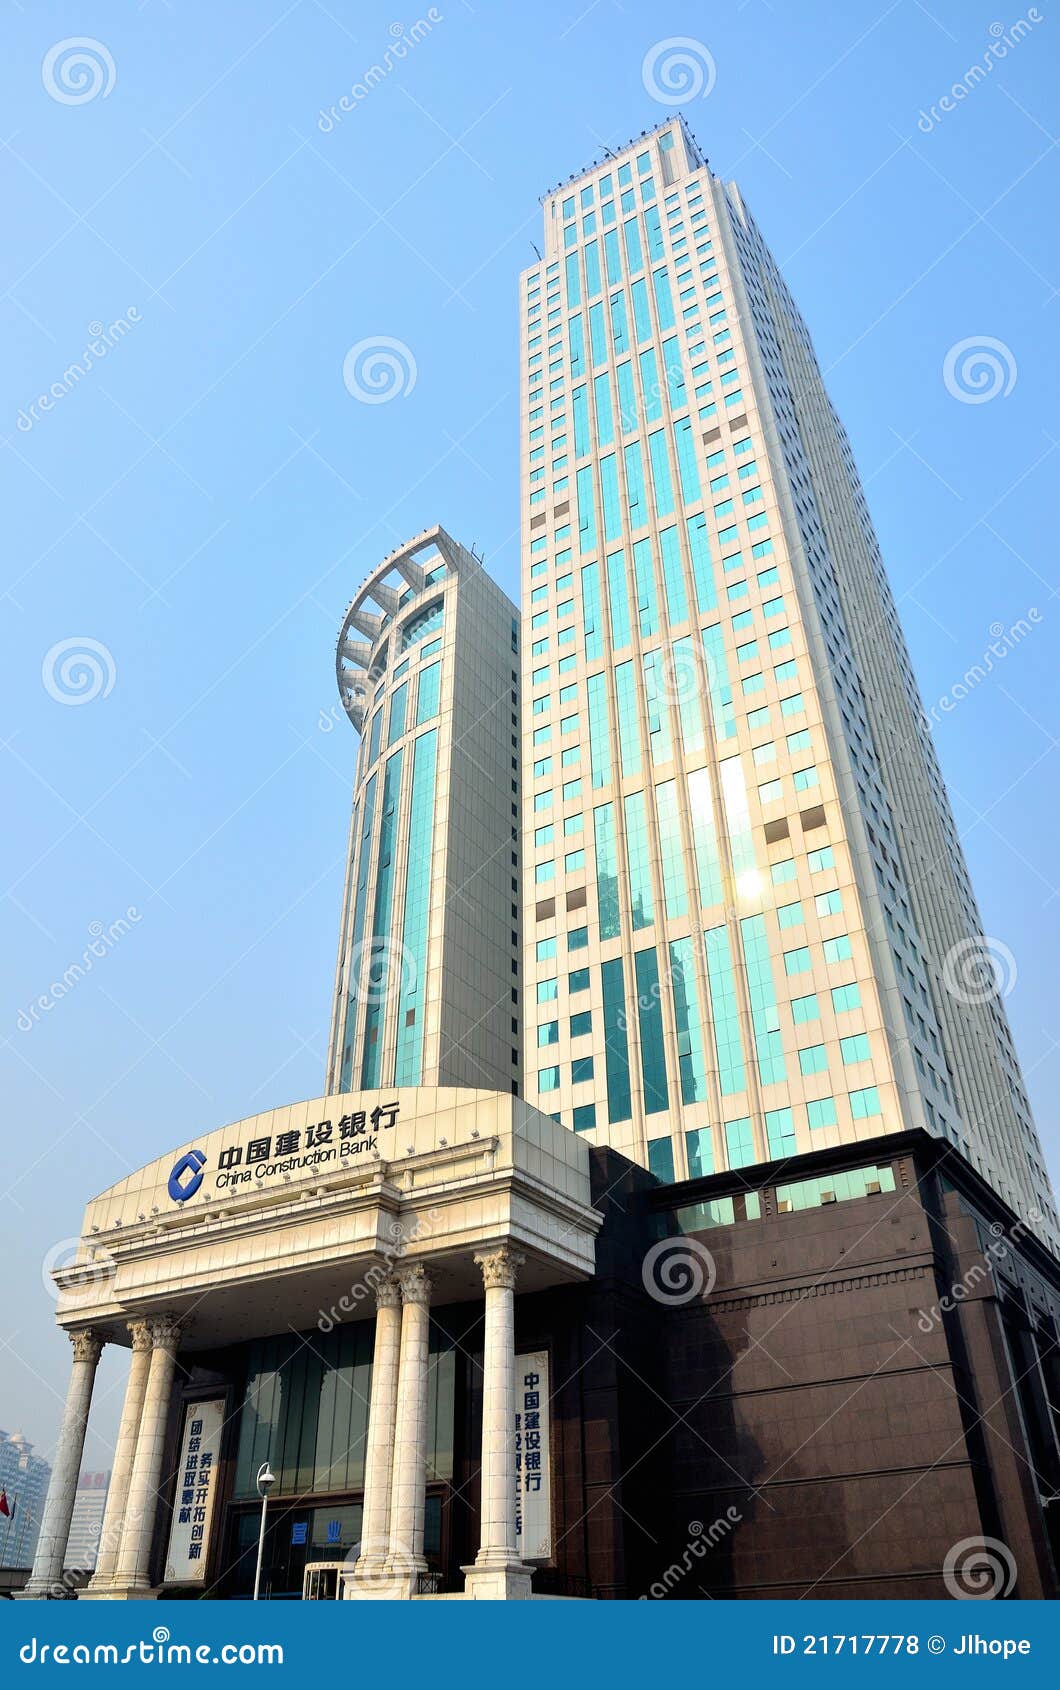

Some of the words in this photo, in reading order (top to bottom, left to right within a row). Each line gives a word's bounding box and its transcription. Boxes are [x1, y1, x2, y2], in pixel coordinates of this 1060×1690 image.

[215, 1171, 251, 1188] China
[255, 1149, 337, 1179] Construction
[340, 1136, 378, 1158] Bank
[218, 1101, 400, 1170] 中国建设银行
[524, 1372, 541, 1492] 中国建设银行
[188, 1452, 213, 1560] 务实开拓创新
